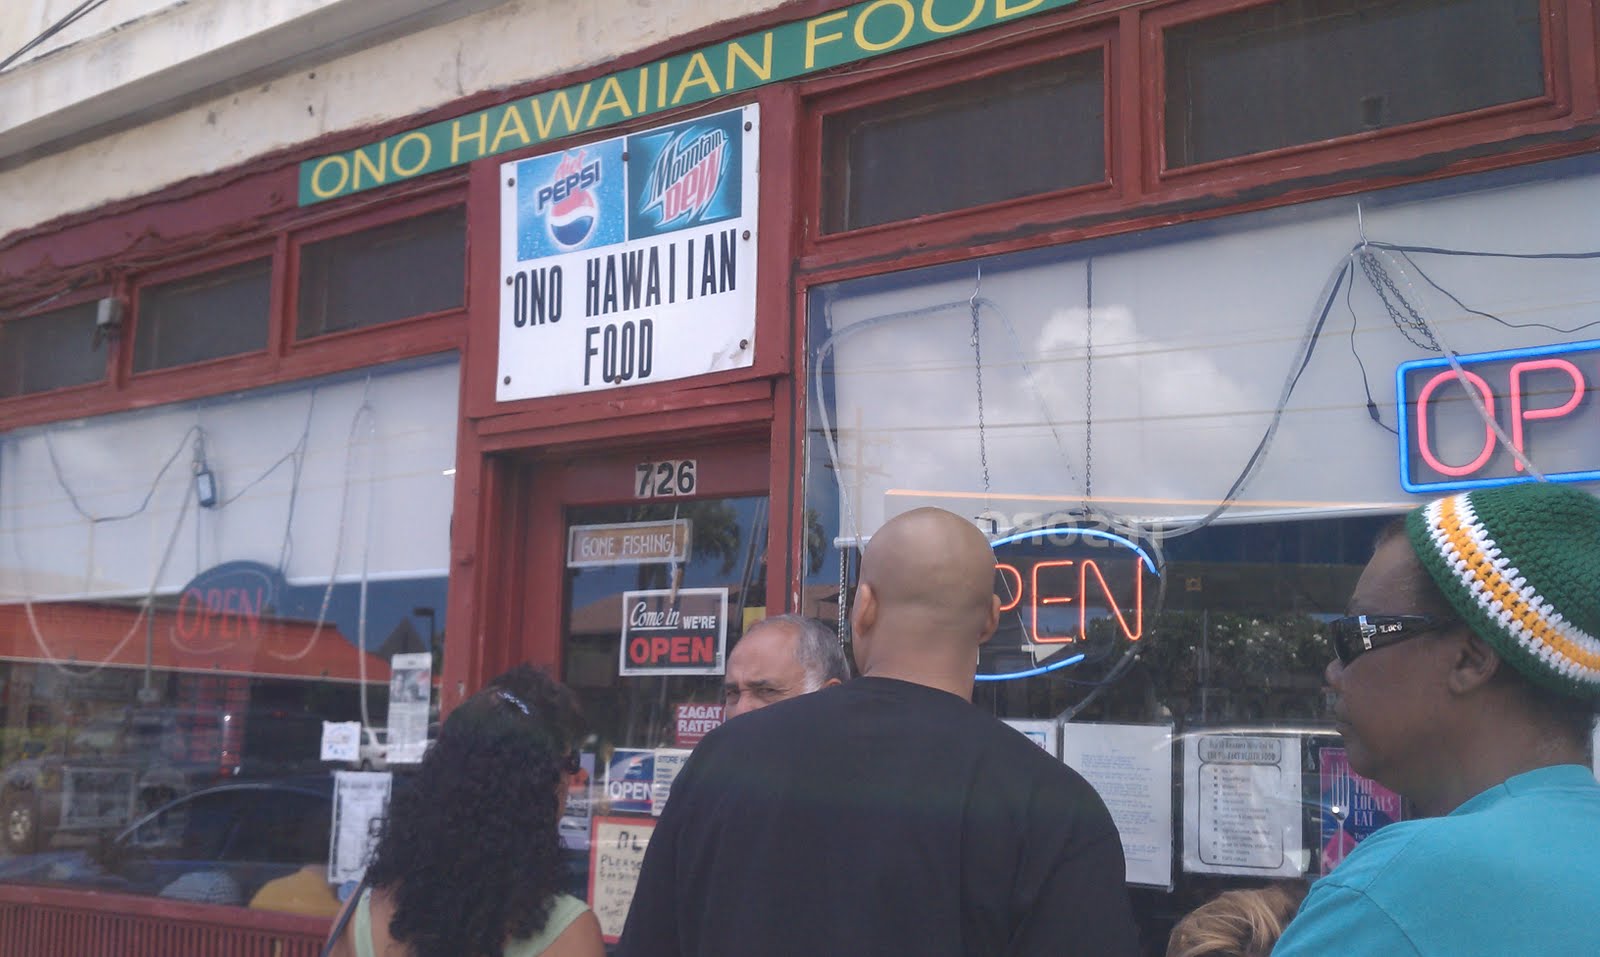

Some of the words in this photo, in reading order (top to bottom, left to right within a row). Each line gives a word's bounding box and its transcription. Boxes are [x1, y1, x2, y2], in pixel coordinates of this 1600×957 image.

[311, 132, 432, 199] ONO
[450, 32, 773, 164] HAWAIIAN
[537, 160, 601, 211] PEPSI
[650, 131, 721, 202] Mountain
[513, 265, 563, 328] ONO
[585, 228, 737, 318] HAWAIIAN
[583, 318, 654, 386] FOOD
[637, 460, 696, 496] 726
[581, 537, 615, 557] GONE
[621, 533, 673, 555] FISHING
[176, 587, 263, 641] OPEN
[629, 601, 664, 627] Come
[664, 608, 681, 626] in
[682, 615, 717, 630] WE'RE
[995, 556, 1144, 644] PEN
[629, 636, 714, 664] OPEN
[677, 705, 723, 719] ZAGAT
[609, 780, 654, 801] OPEN
[1354, 811, 1375, 827] EAT
